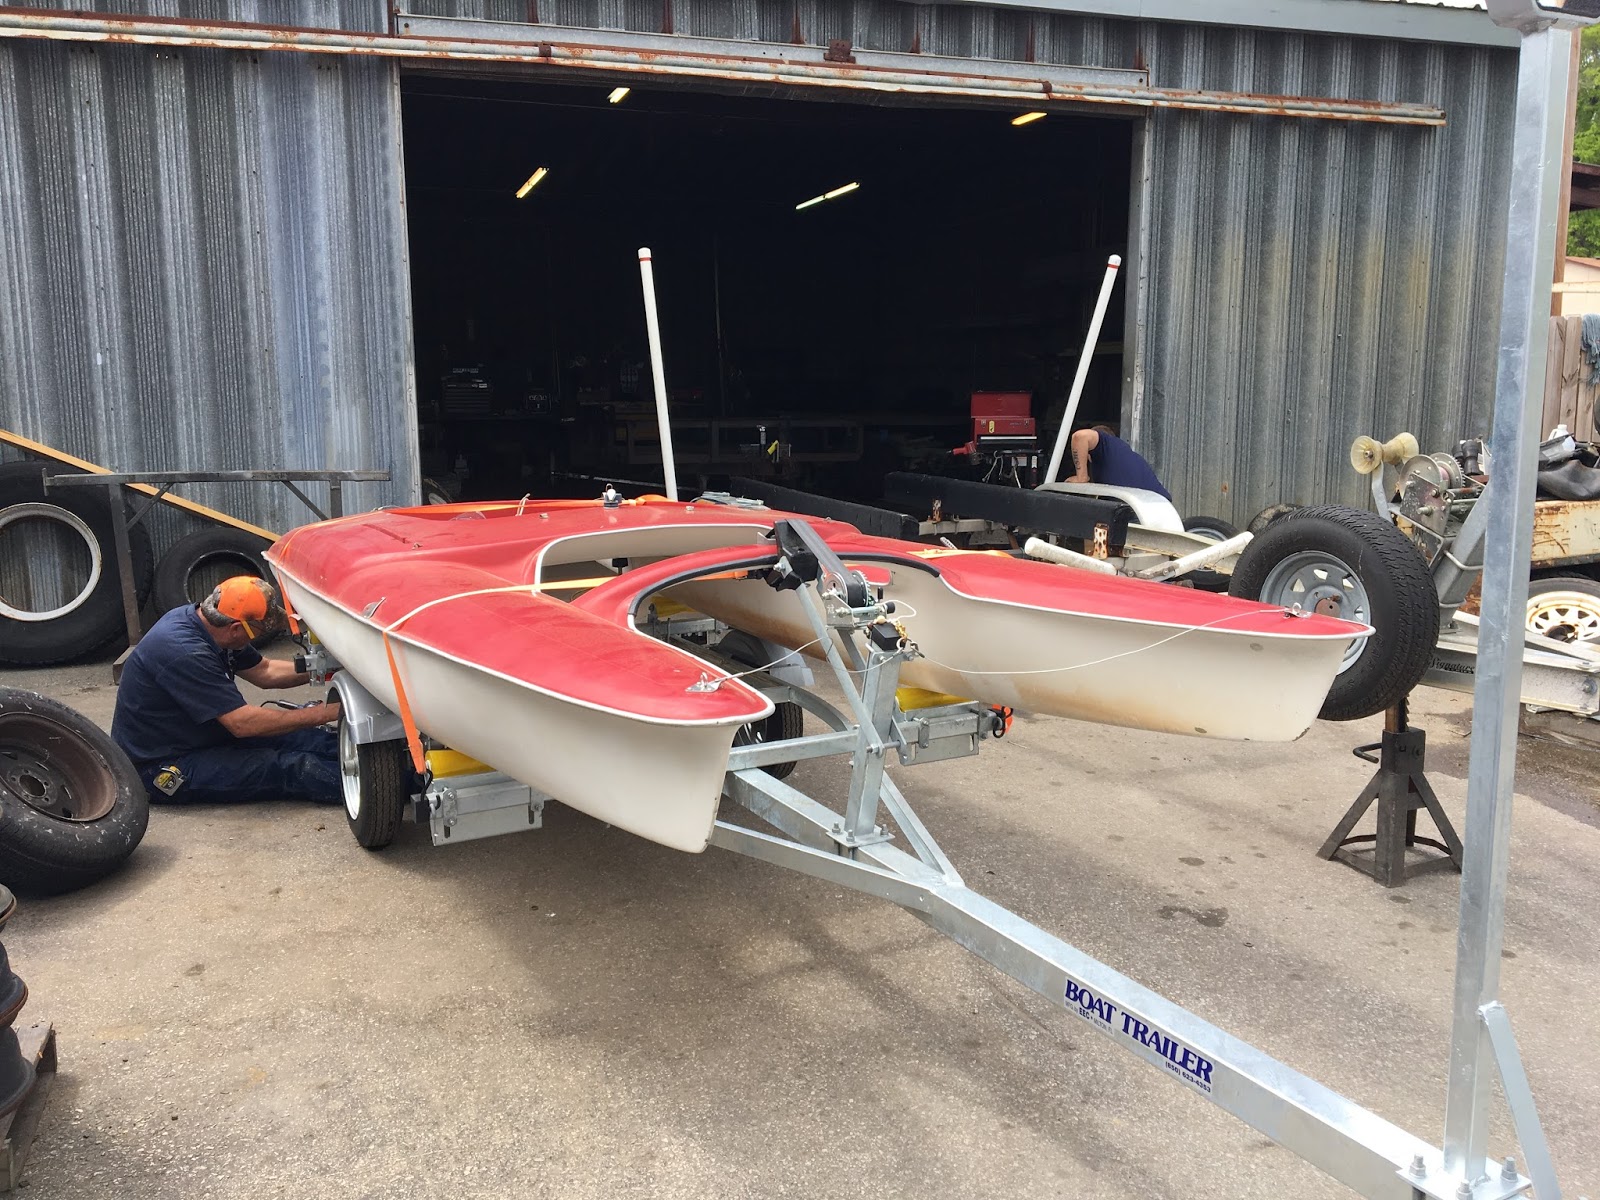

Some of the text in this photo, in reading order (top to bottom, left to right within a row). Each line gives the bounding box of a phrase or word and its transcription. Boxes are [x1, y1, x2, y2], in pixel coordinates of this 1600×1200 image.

[1429, 657, 1475, 671] Signature
[1065, 979, 1214, 1084] BOAT TRAILER
